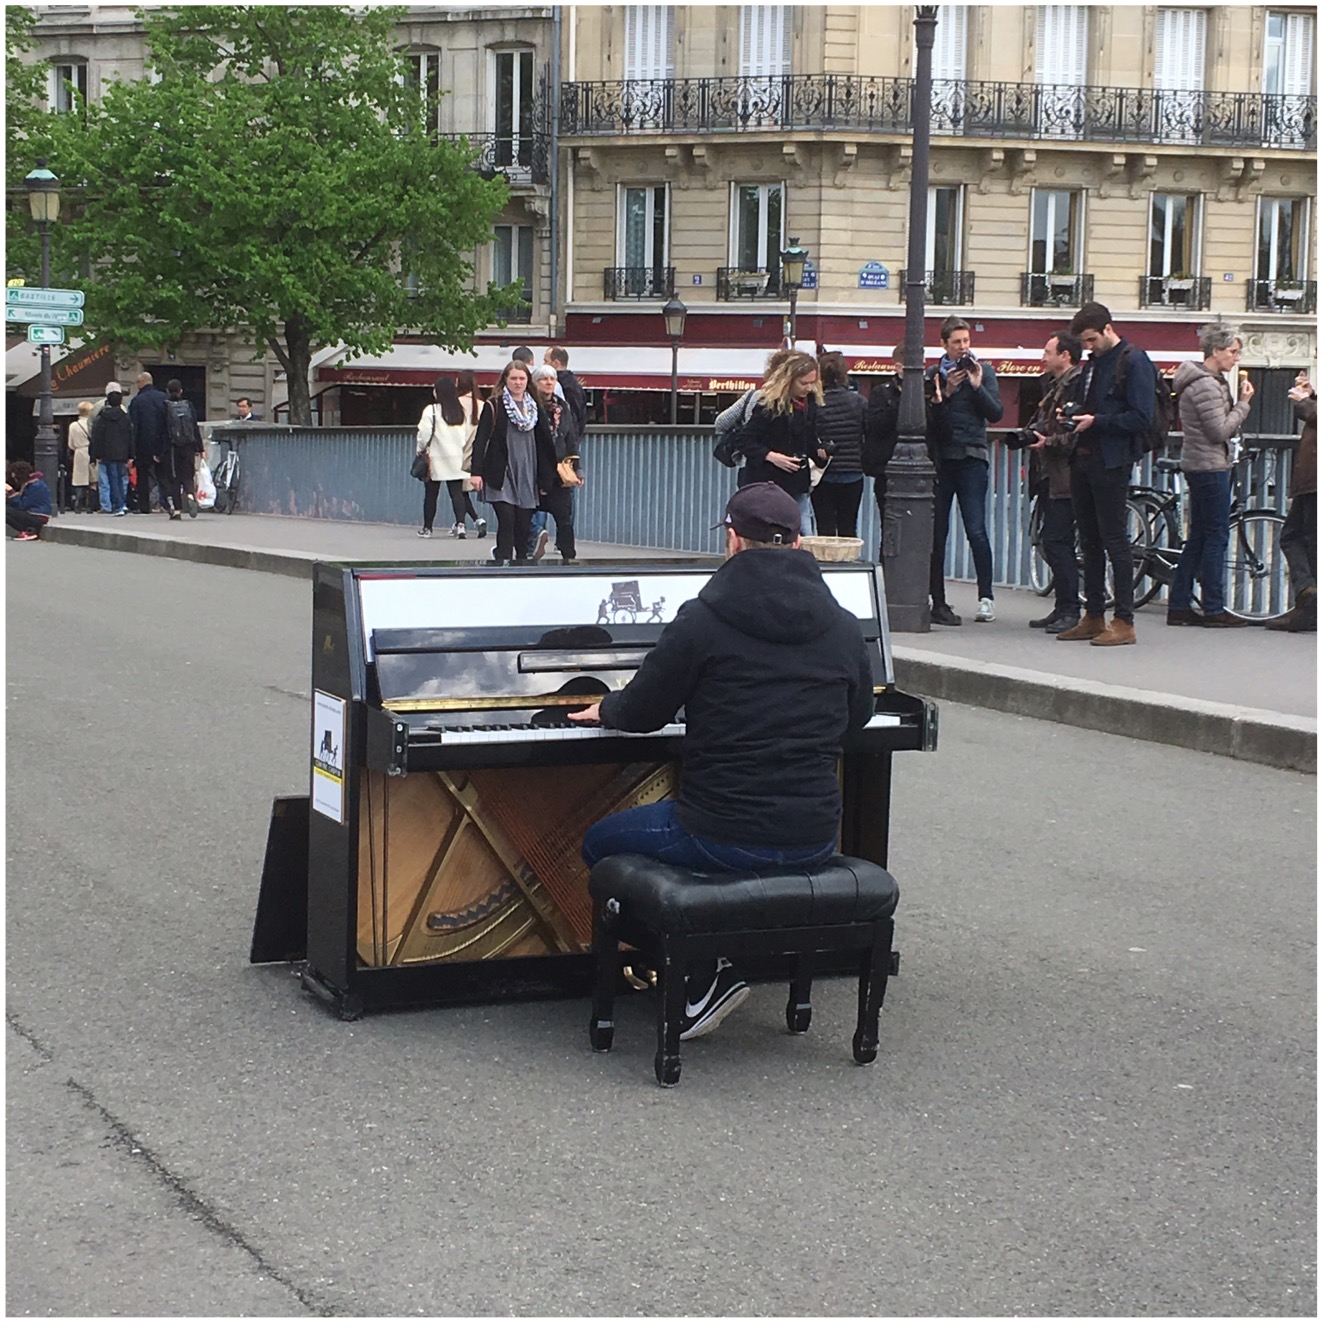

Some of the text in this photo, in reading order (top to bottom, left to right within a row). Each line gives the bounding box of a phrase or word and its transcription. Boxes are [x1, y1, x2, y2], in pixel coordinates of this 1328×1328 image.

[693, 275, 701, 284] 2
[996, 360, 1026, 372] Flore
[708, 378, 757, 391] Berthillon
